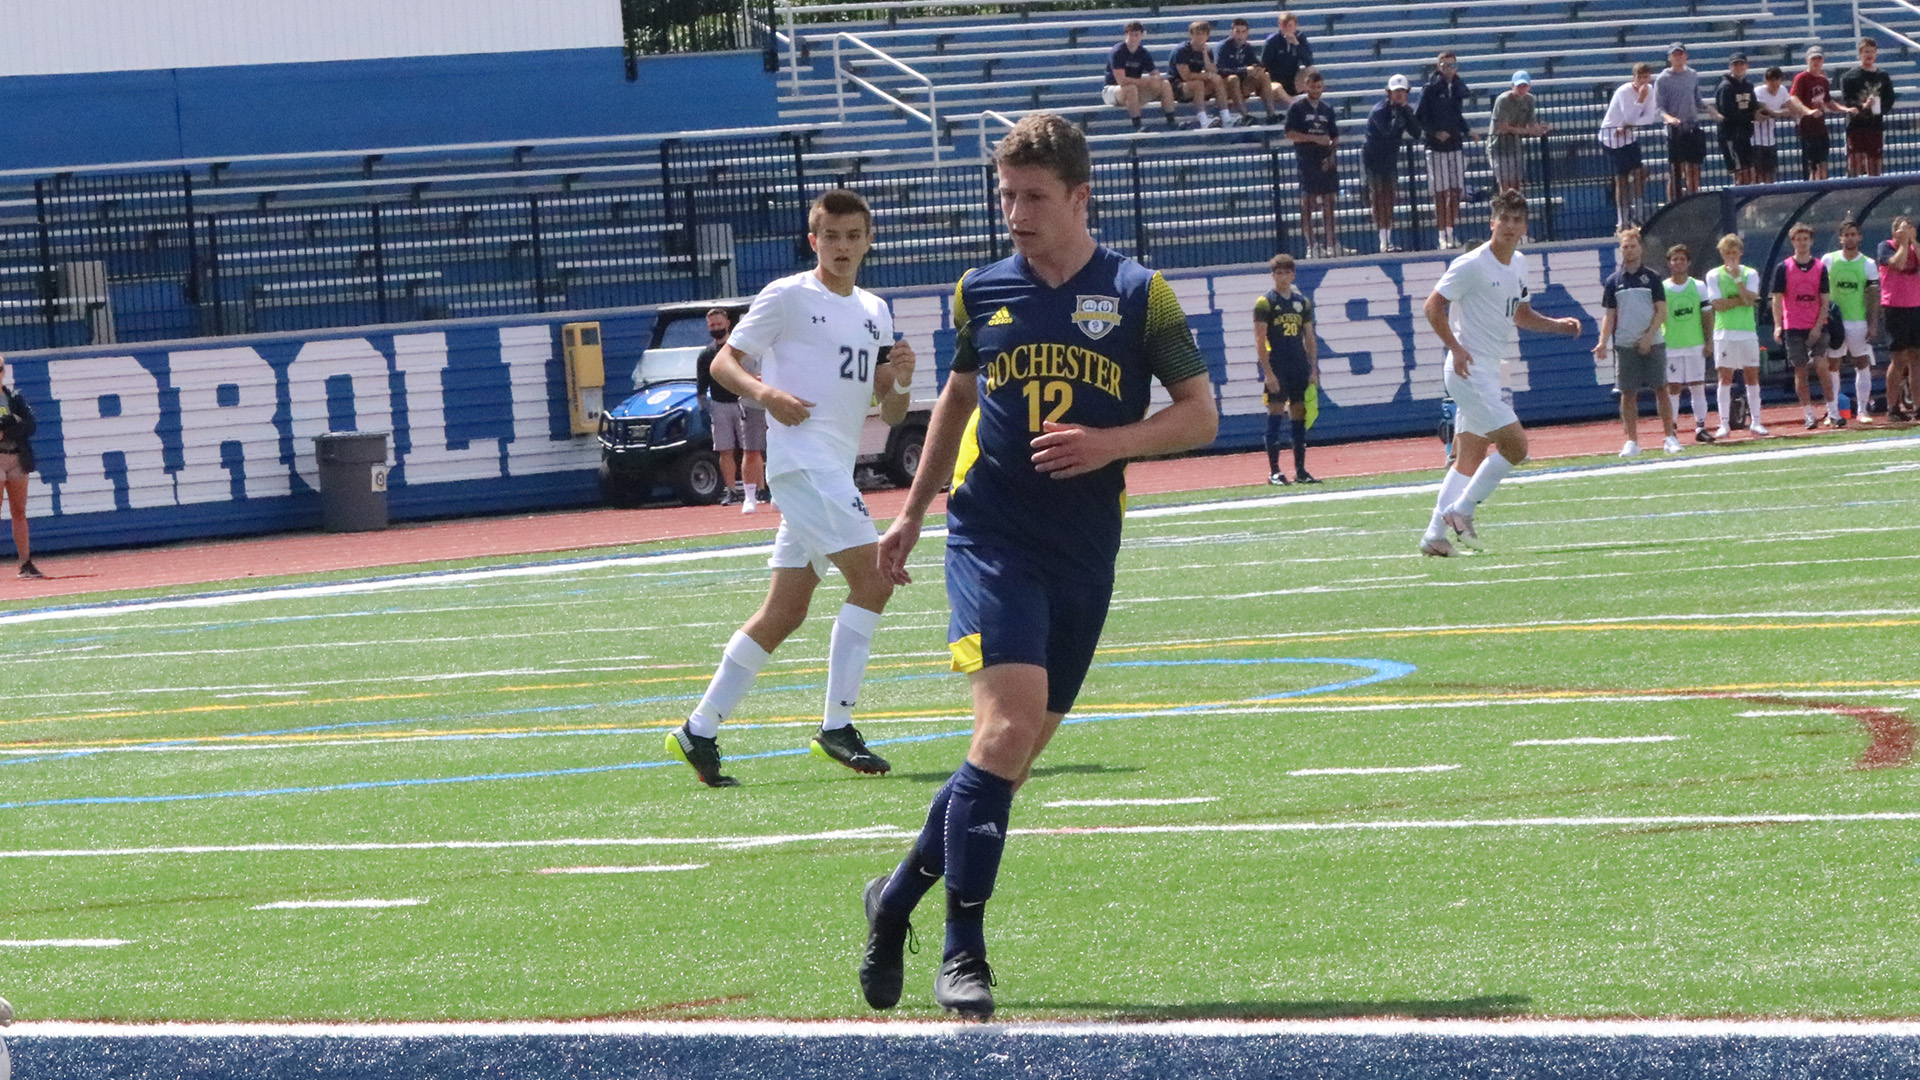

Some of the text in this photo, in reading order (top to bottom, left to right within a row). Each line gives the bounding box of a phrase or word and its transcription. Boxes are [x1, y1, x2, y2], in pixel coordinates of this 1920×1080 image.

[1282, 322, 1298, 337] 20
[839, 346, 869, 382] 20
[986, 343, 1122, 400] ROCHESTER
[1022, 380, 1073, 432] 12
